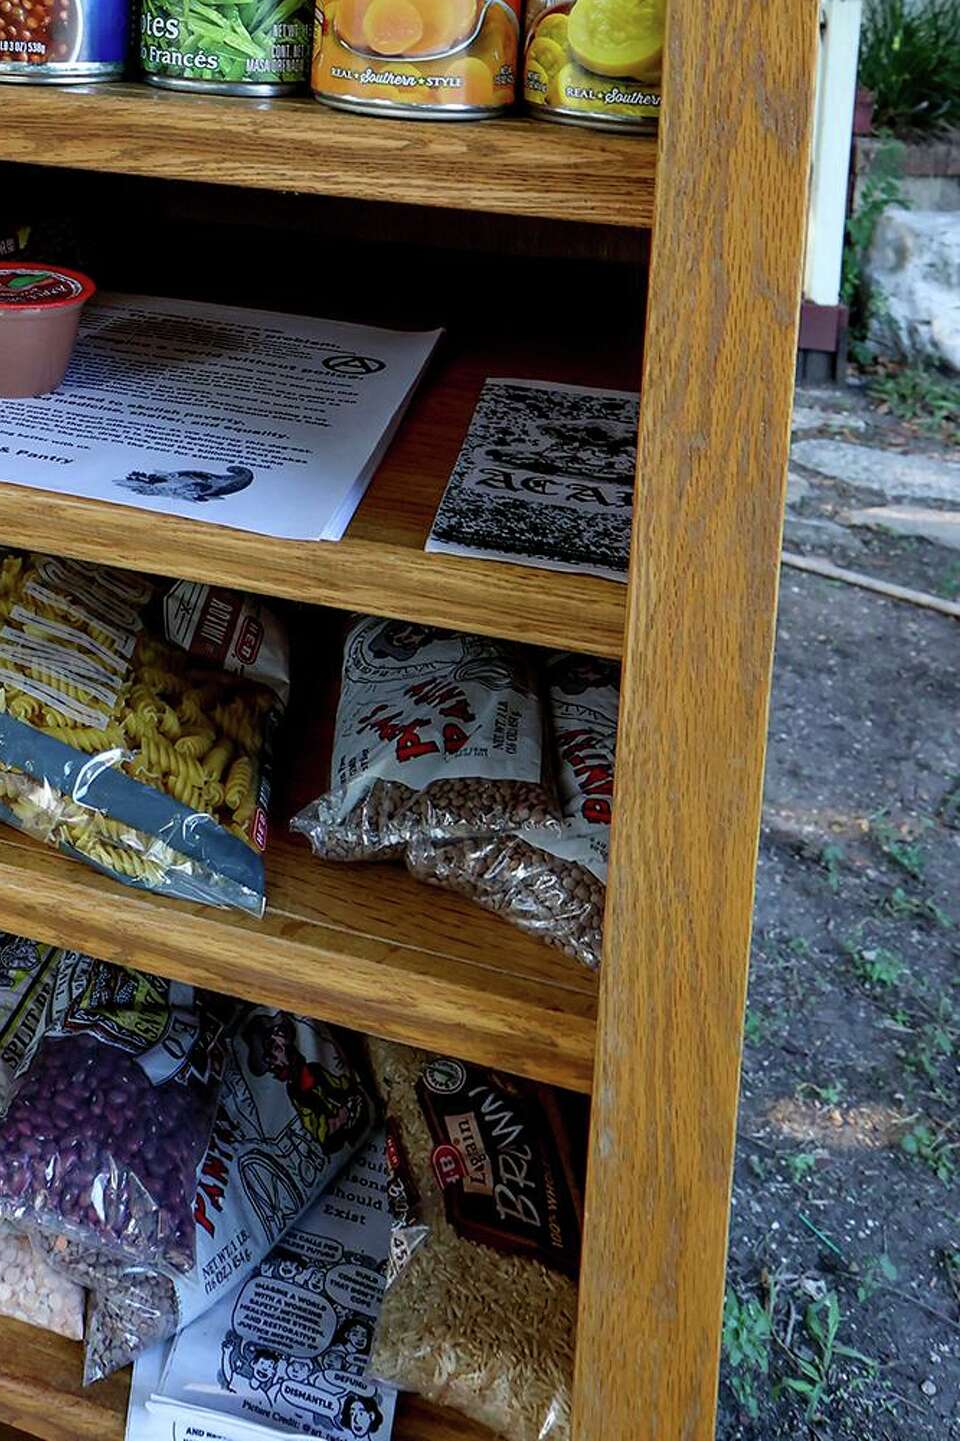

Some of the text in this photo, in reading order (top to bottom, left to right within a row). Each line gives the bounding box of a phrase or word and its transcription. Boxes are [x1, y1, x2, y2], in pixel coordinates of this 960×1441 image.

[149, 46, 219, 70] Francés
[360, 68, 417, 86] Southern
[566, 87, 596, 99] REAL
[15, 449, 74, 463] Pantry
[0, 1006, 44, 1068] SPLIT
[323, 1204, 366, 1225] Exist
[284, 1386, 335, 1411] DISMANTLE.
[186, 1427, 204, 1439] AND
